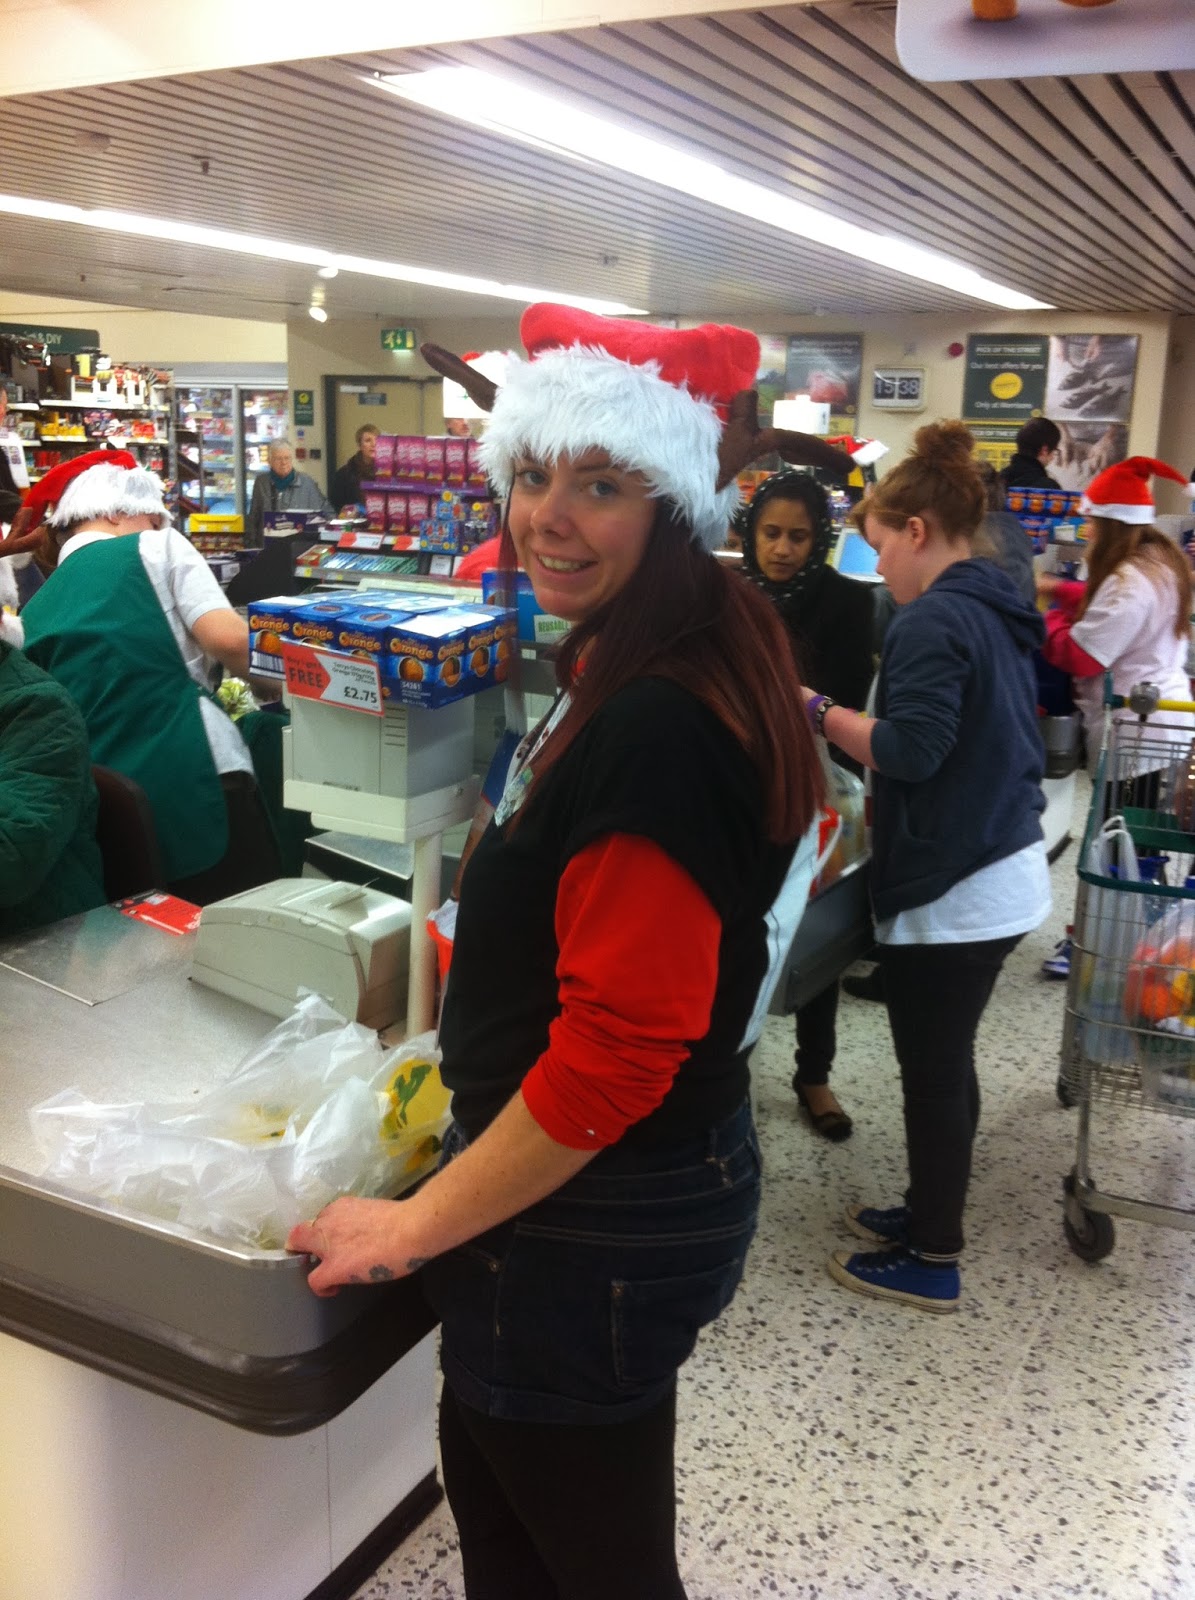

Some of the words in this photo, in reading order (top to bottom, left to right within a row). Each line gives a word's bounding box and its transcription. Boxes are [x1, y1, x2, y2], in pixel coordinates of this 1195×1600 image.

[46, 333, 62, 344] DIY
[876, 380, 893, 394] 15
[899, 380, 918, 395] 38
[288, 667, 324, 688] FREE
[343, 686, 378, 703] £2.75
